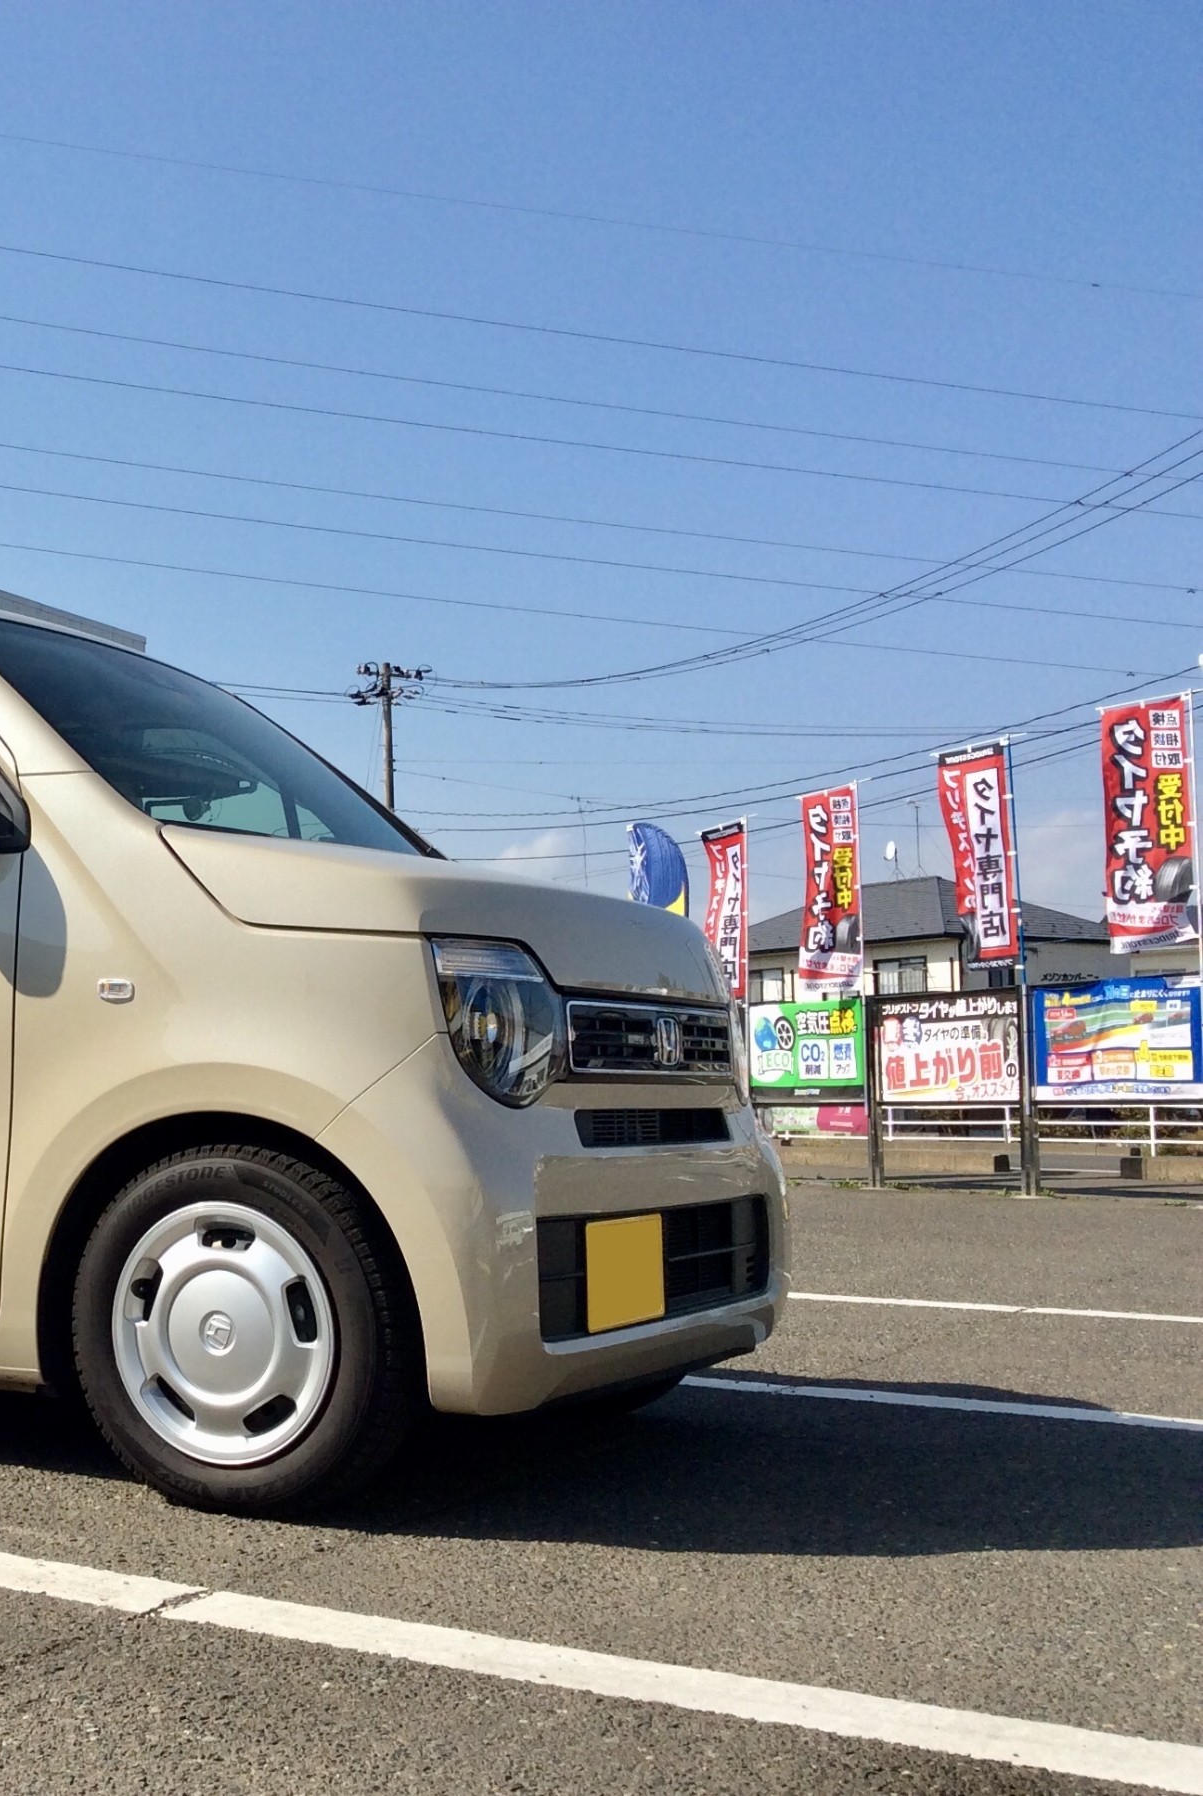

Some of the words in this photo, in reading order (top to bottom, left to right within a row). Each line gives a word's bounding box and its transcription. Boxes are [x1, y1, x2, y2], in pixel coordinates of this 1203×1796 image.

[766, 1052, 790, 1068] ECO
[833, 1043, 852, 1061] 燃費
[886, 1041, 1017, 1091] 値上がり前の
